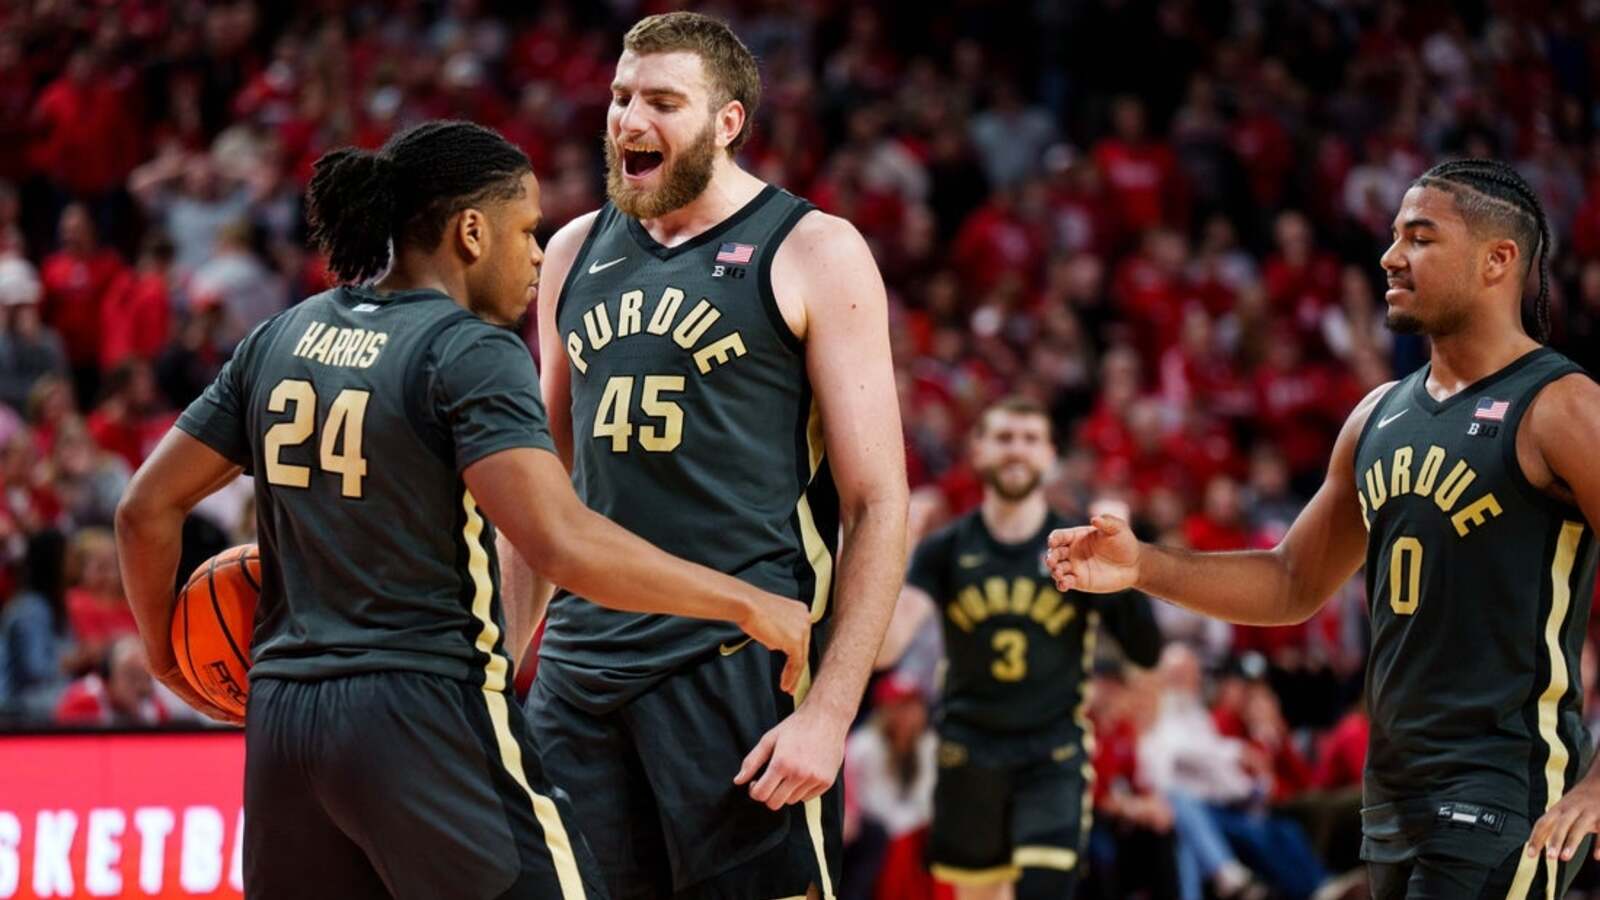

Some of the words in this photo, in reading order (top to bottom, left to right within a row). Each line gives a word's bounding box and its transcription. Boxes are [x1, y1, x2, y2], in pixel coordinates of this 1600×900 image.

[293, 320, 389, 369] HARRIS
[567, 286, 748, 375] PURDUE
[264, 378, 371, 498] 24
[592, 375, 686, 453] 45
[1389, 535, 1424, 616] 0
[991, 628, 1028, 683] 3
